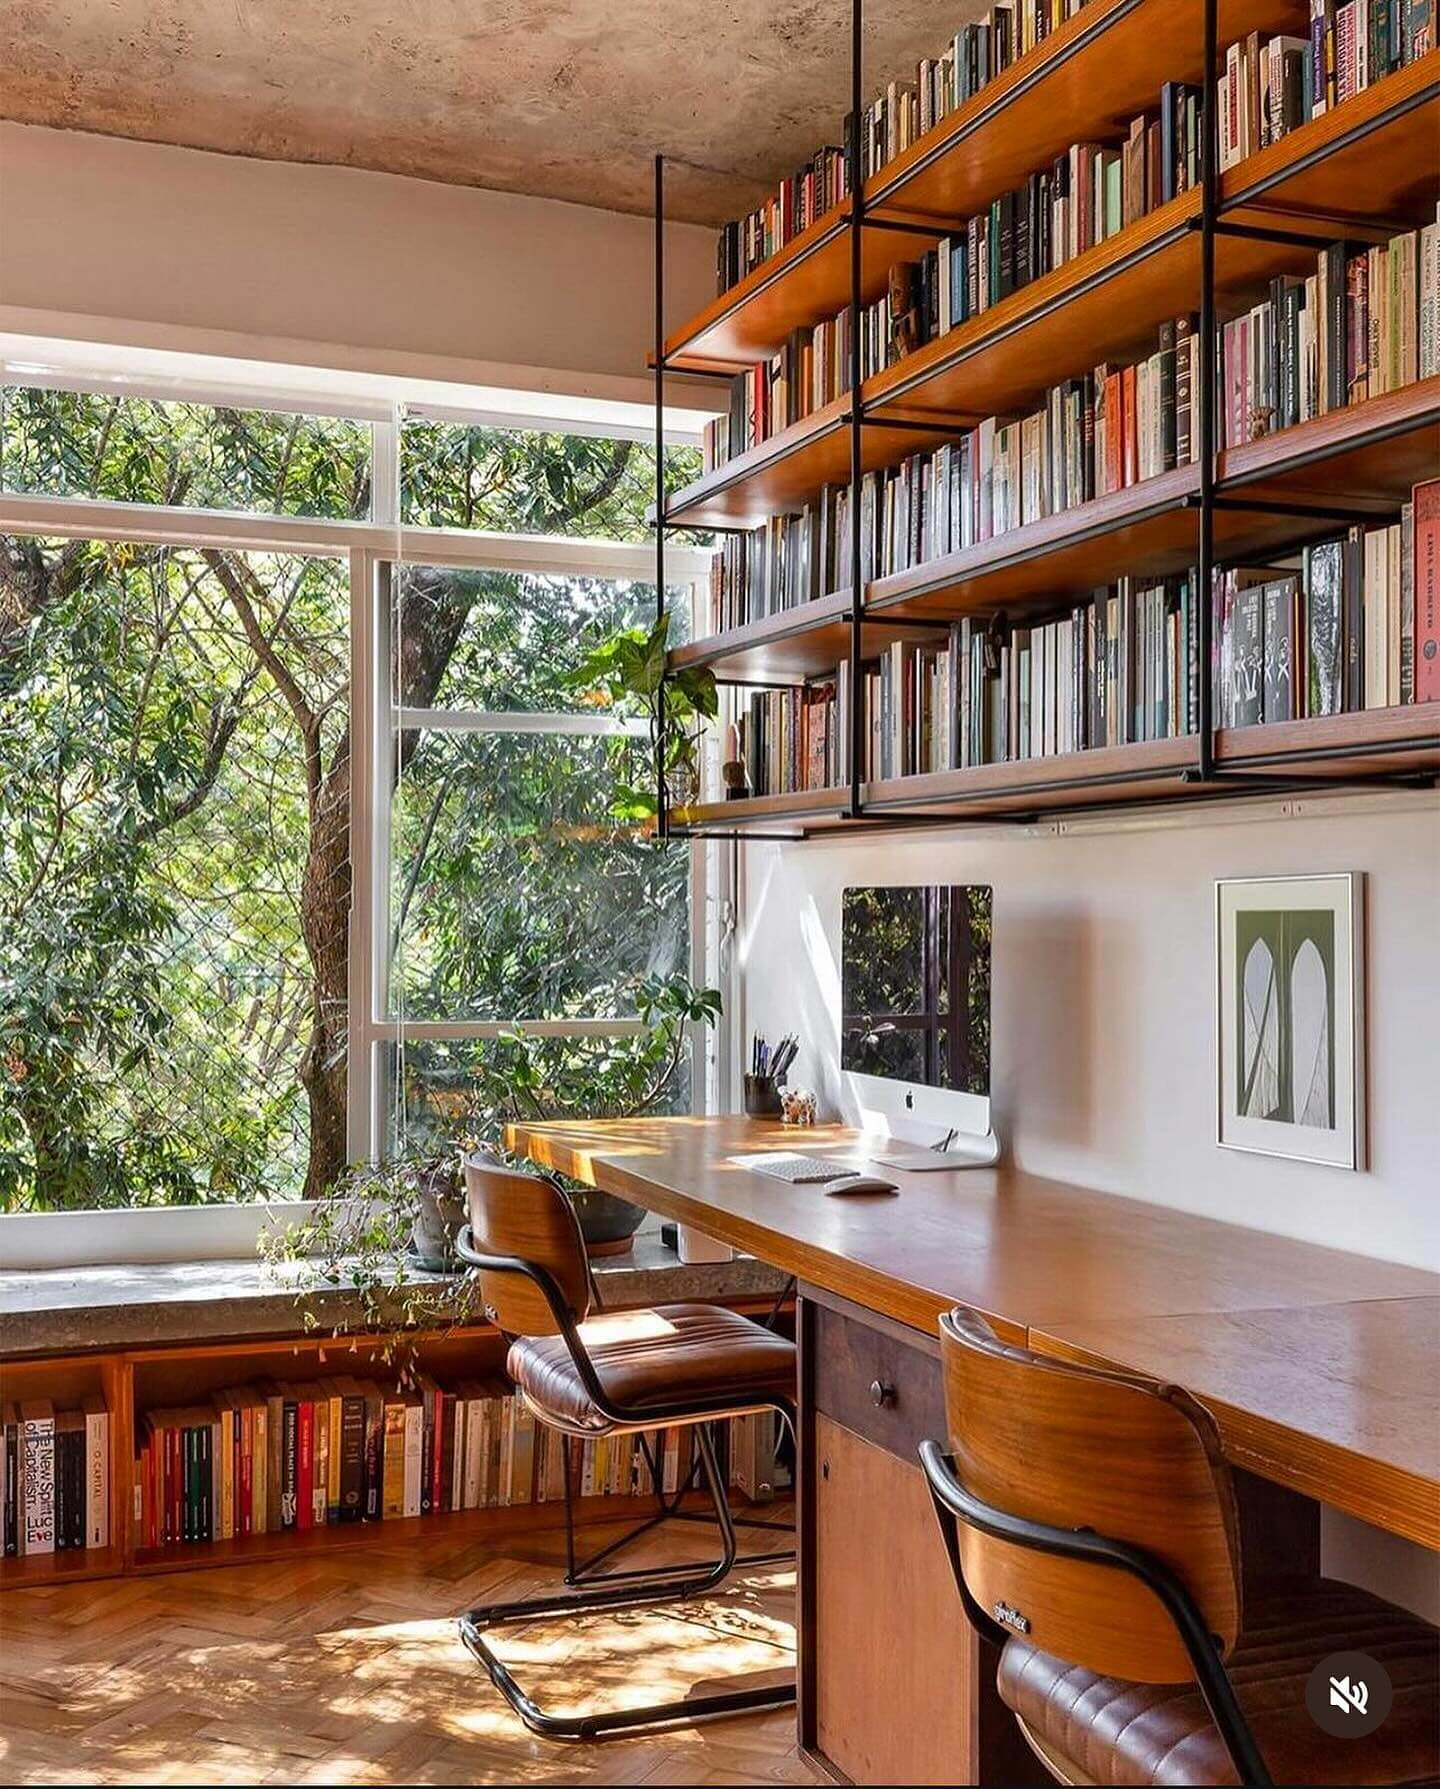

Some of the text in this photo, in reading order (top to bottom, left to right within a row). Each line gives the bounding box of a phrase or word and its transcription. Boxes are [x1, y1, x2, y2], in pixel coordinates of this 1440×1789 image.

[26, 1422, 40, 1437] of
[37, 1421, 54, 1515] The New Spirit
[27, 1517, 53, 1529] Luc
